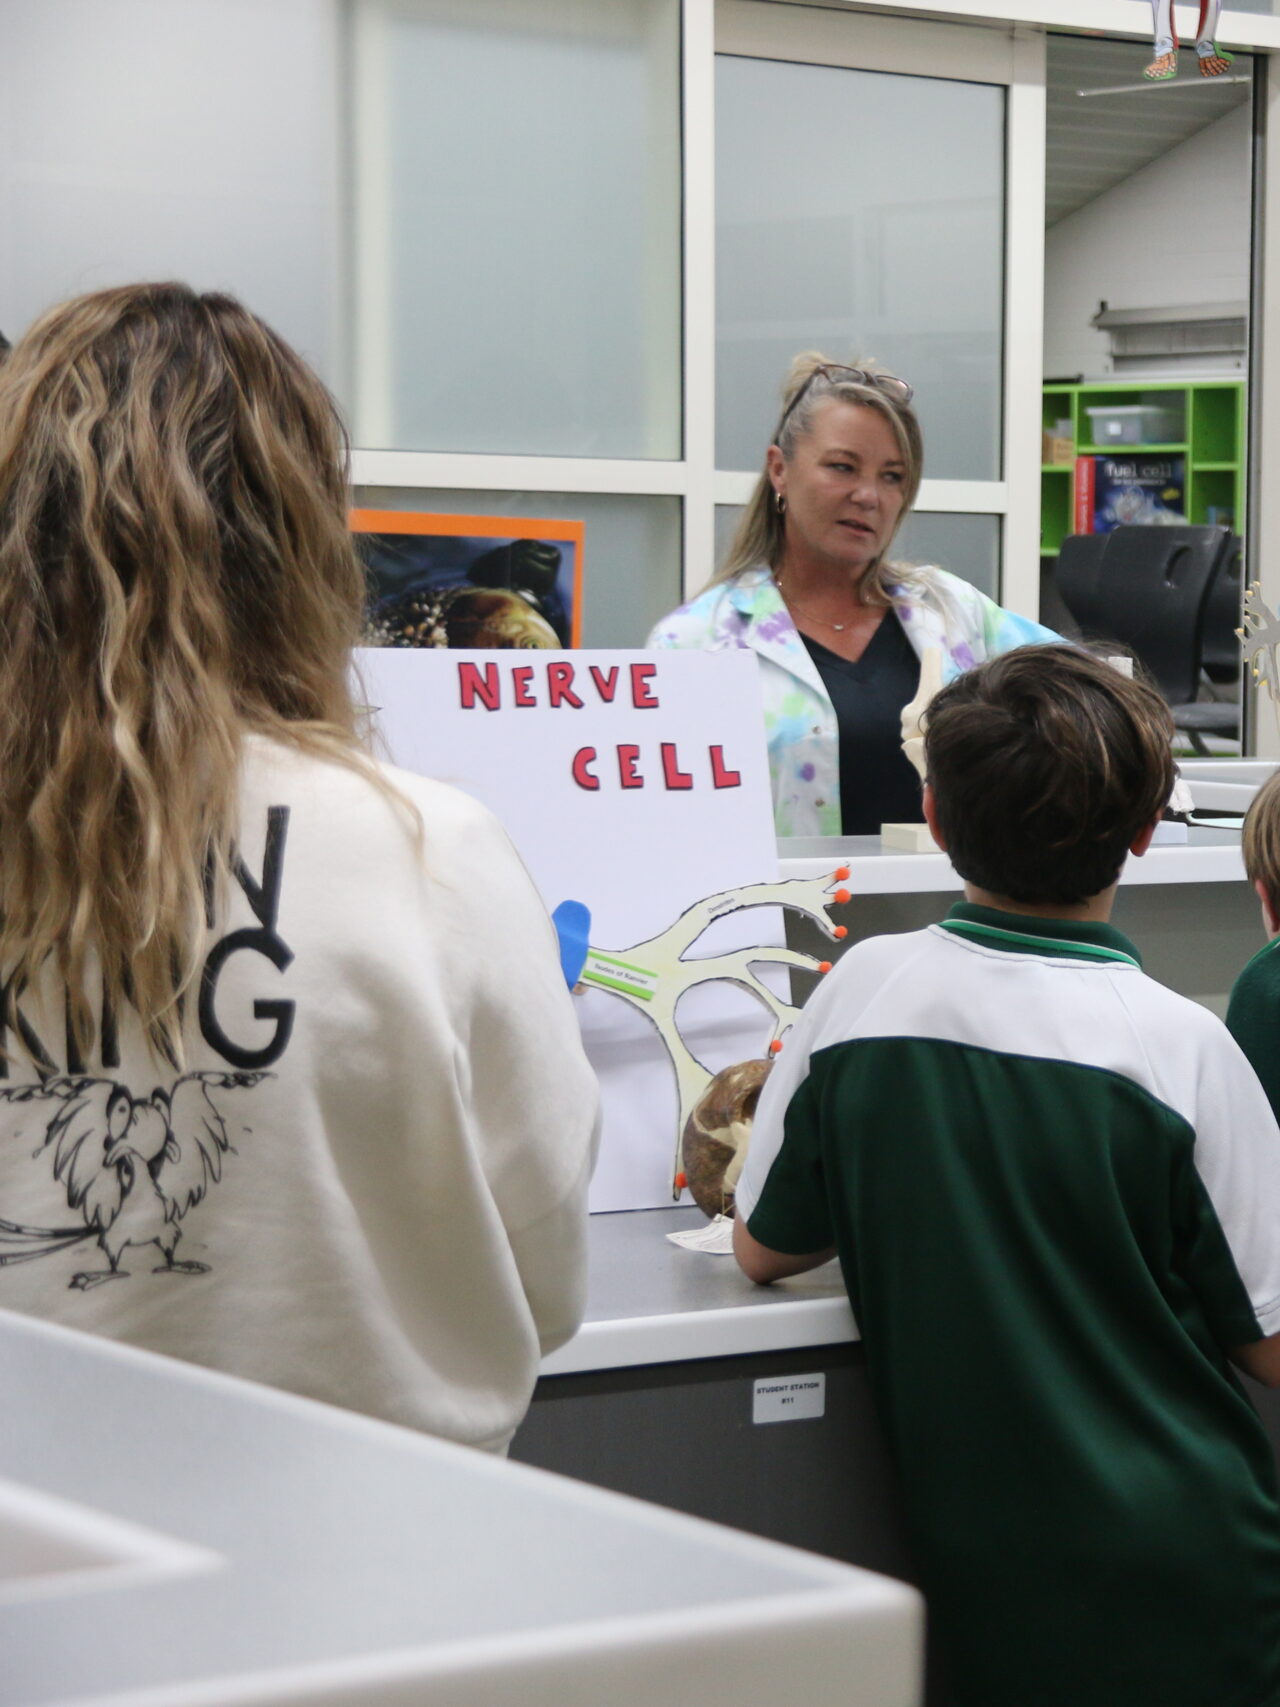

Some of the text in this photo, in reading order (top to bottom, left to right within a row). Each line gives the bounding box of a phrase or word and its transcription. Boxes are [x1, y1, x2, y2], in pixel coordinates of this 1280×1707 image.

[1105, 461, 1171, 478] fuel cell
[457, 661, 660, 712] NERVE
[571, 742, 742, 791] CELL
[756, 1382, 820, 1394] STUDENT STATION
